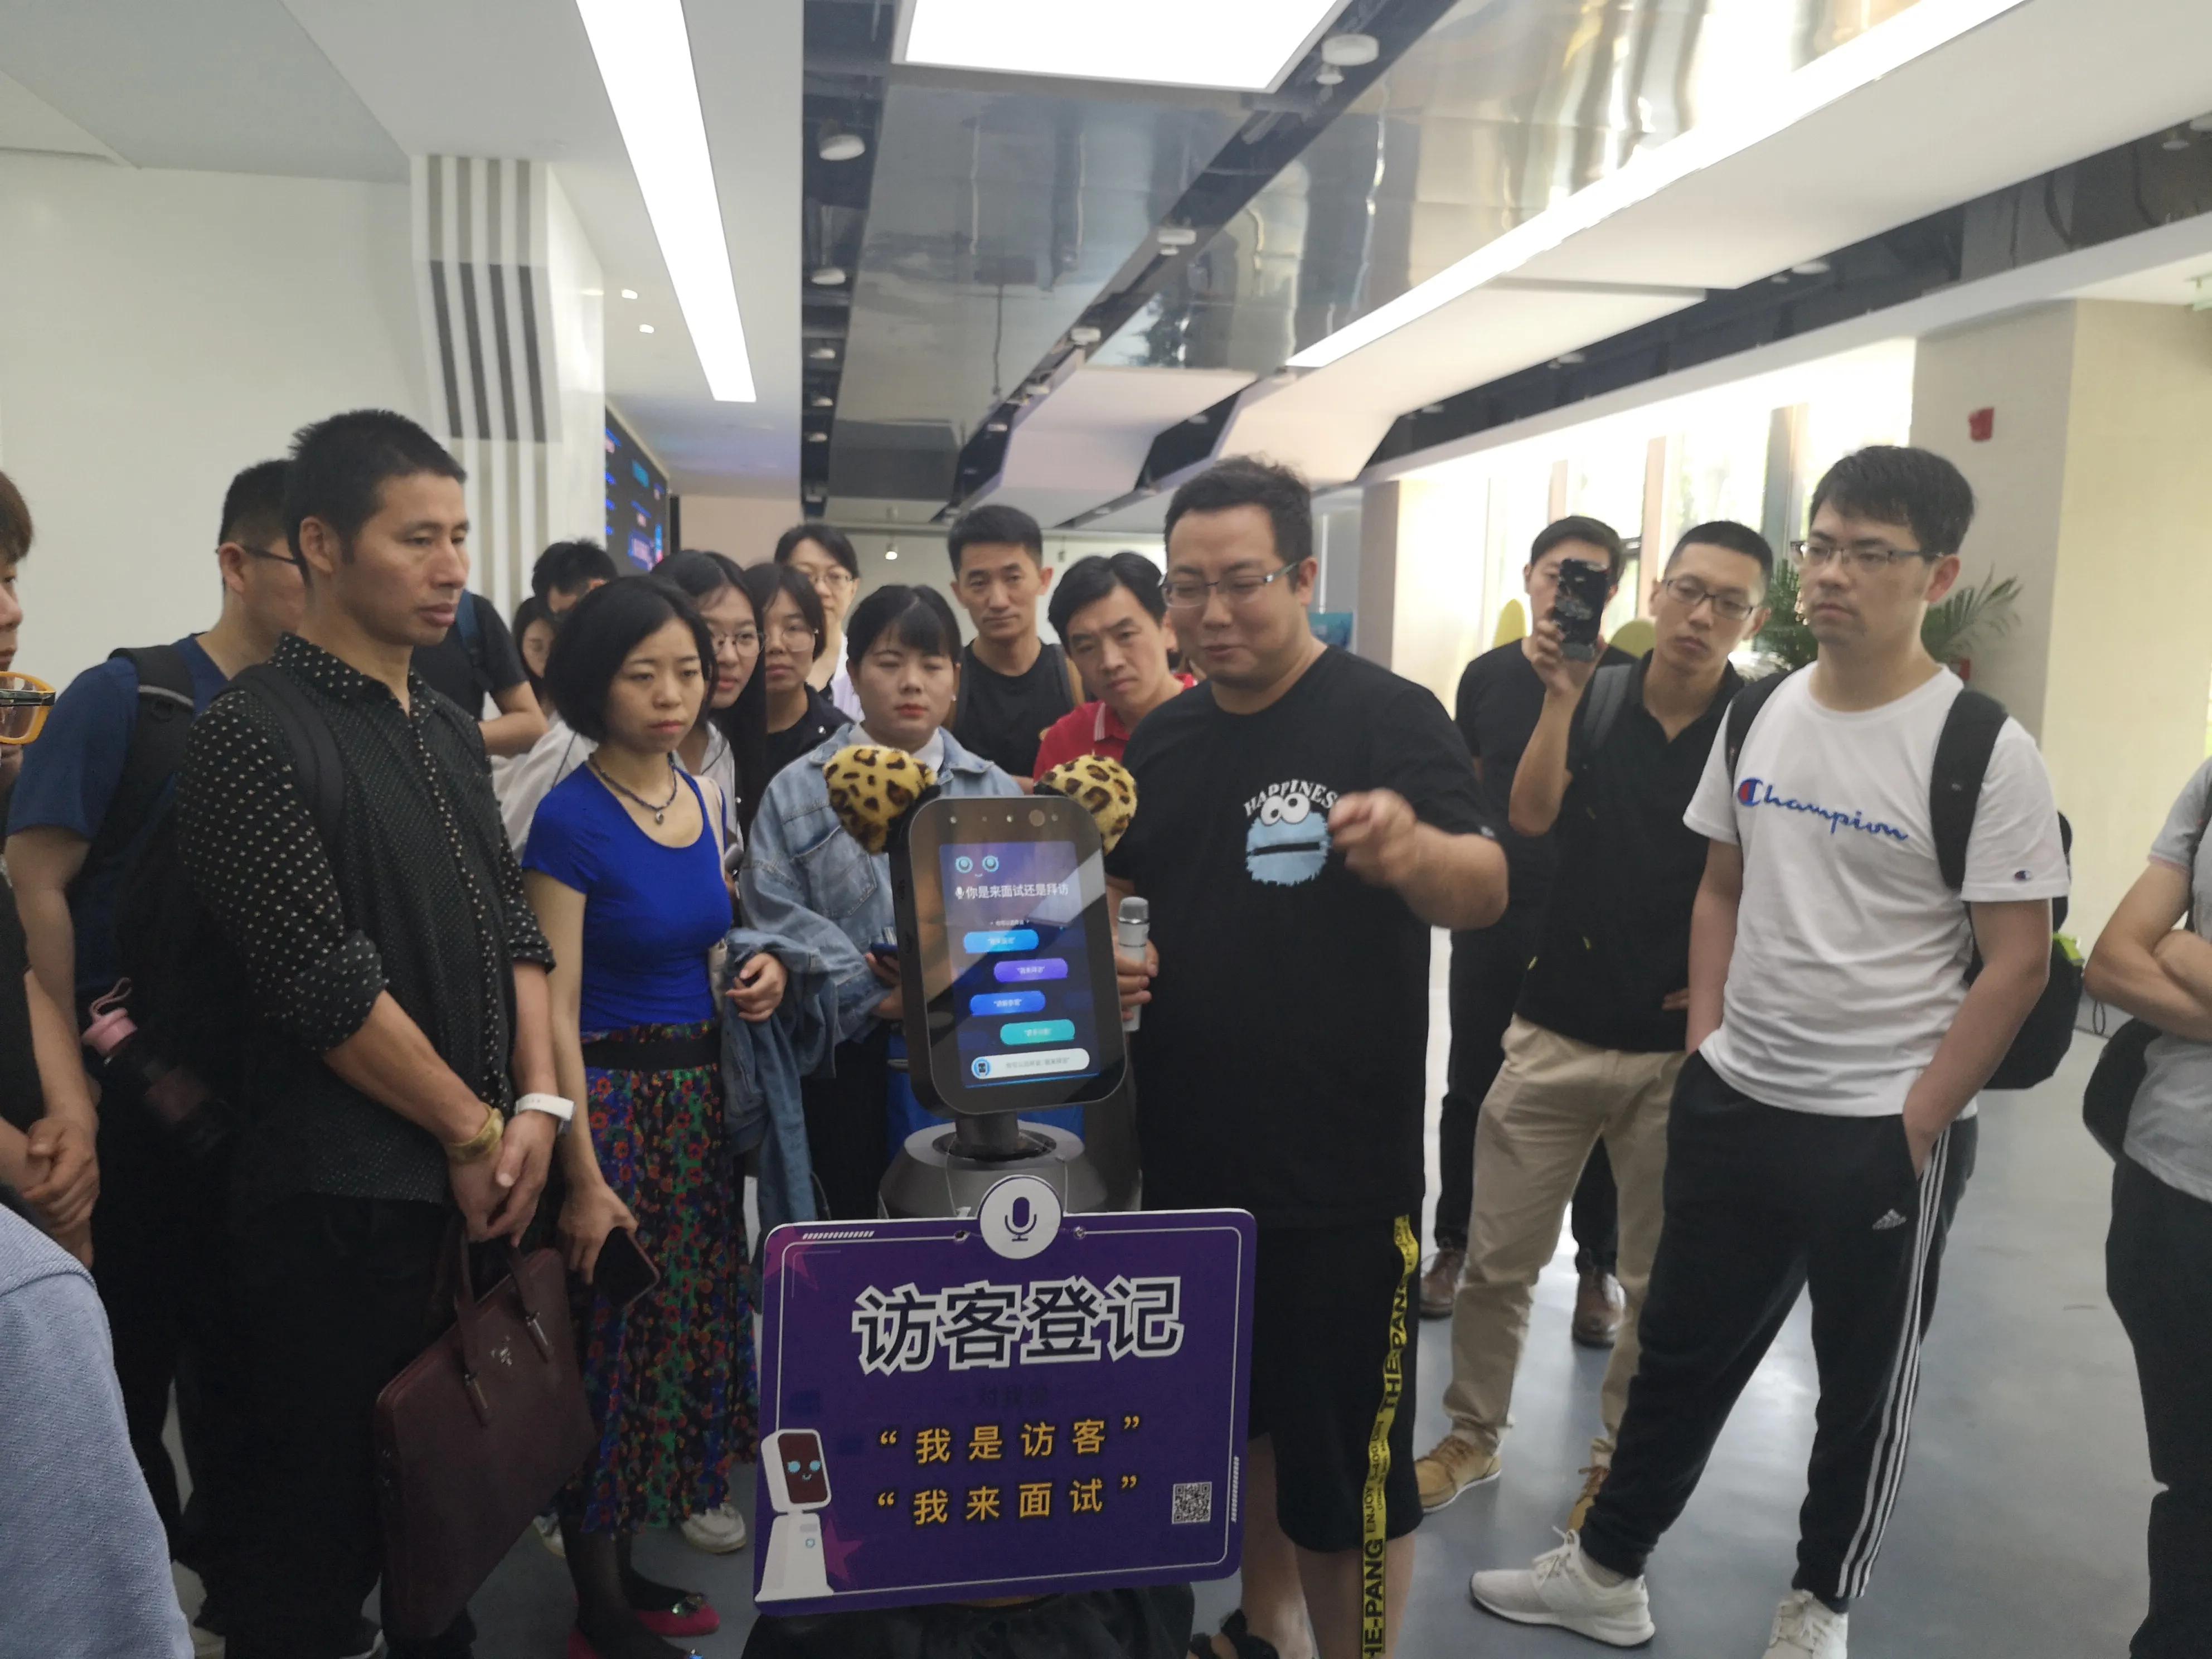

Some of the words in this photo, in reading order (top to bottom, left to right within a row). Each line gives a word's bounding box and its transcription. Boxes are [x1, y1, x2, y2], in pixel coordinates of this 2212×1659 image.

[1243, 778, 1338, 818] HAPPINES
[1738, 777, 1909, 841] Champion
[852, 1274, 1184, 1375] 访客登记
